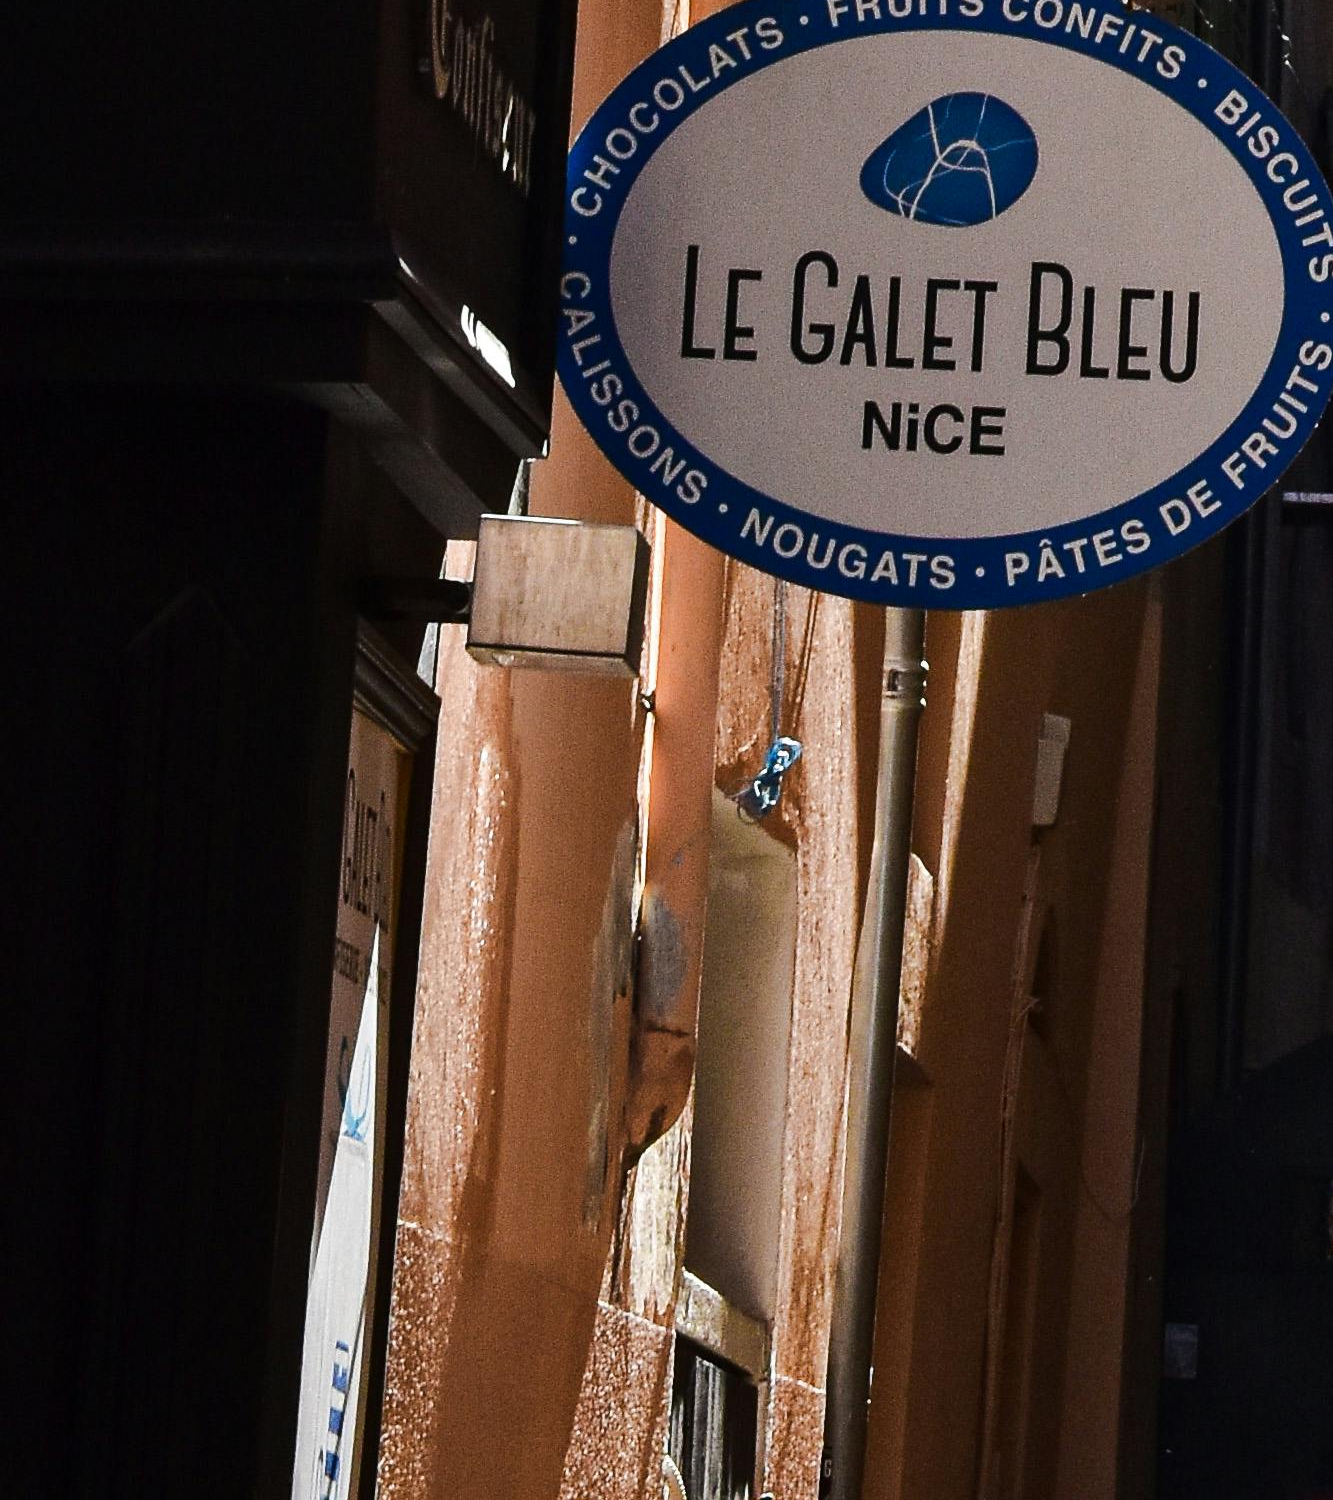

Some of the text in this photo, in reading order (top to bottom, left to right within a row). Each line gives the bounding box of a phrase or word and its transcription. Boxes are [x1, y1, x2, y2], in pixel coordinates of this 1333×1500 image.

[570, 17, 785, 217] CHOCOLATS
[680, 243, 1201, 384] LE GALET BLEU
[560, 270, 1333, 589] CALISSONS NOUGATS PÂTES DE FRUITS
